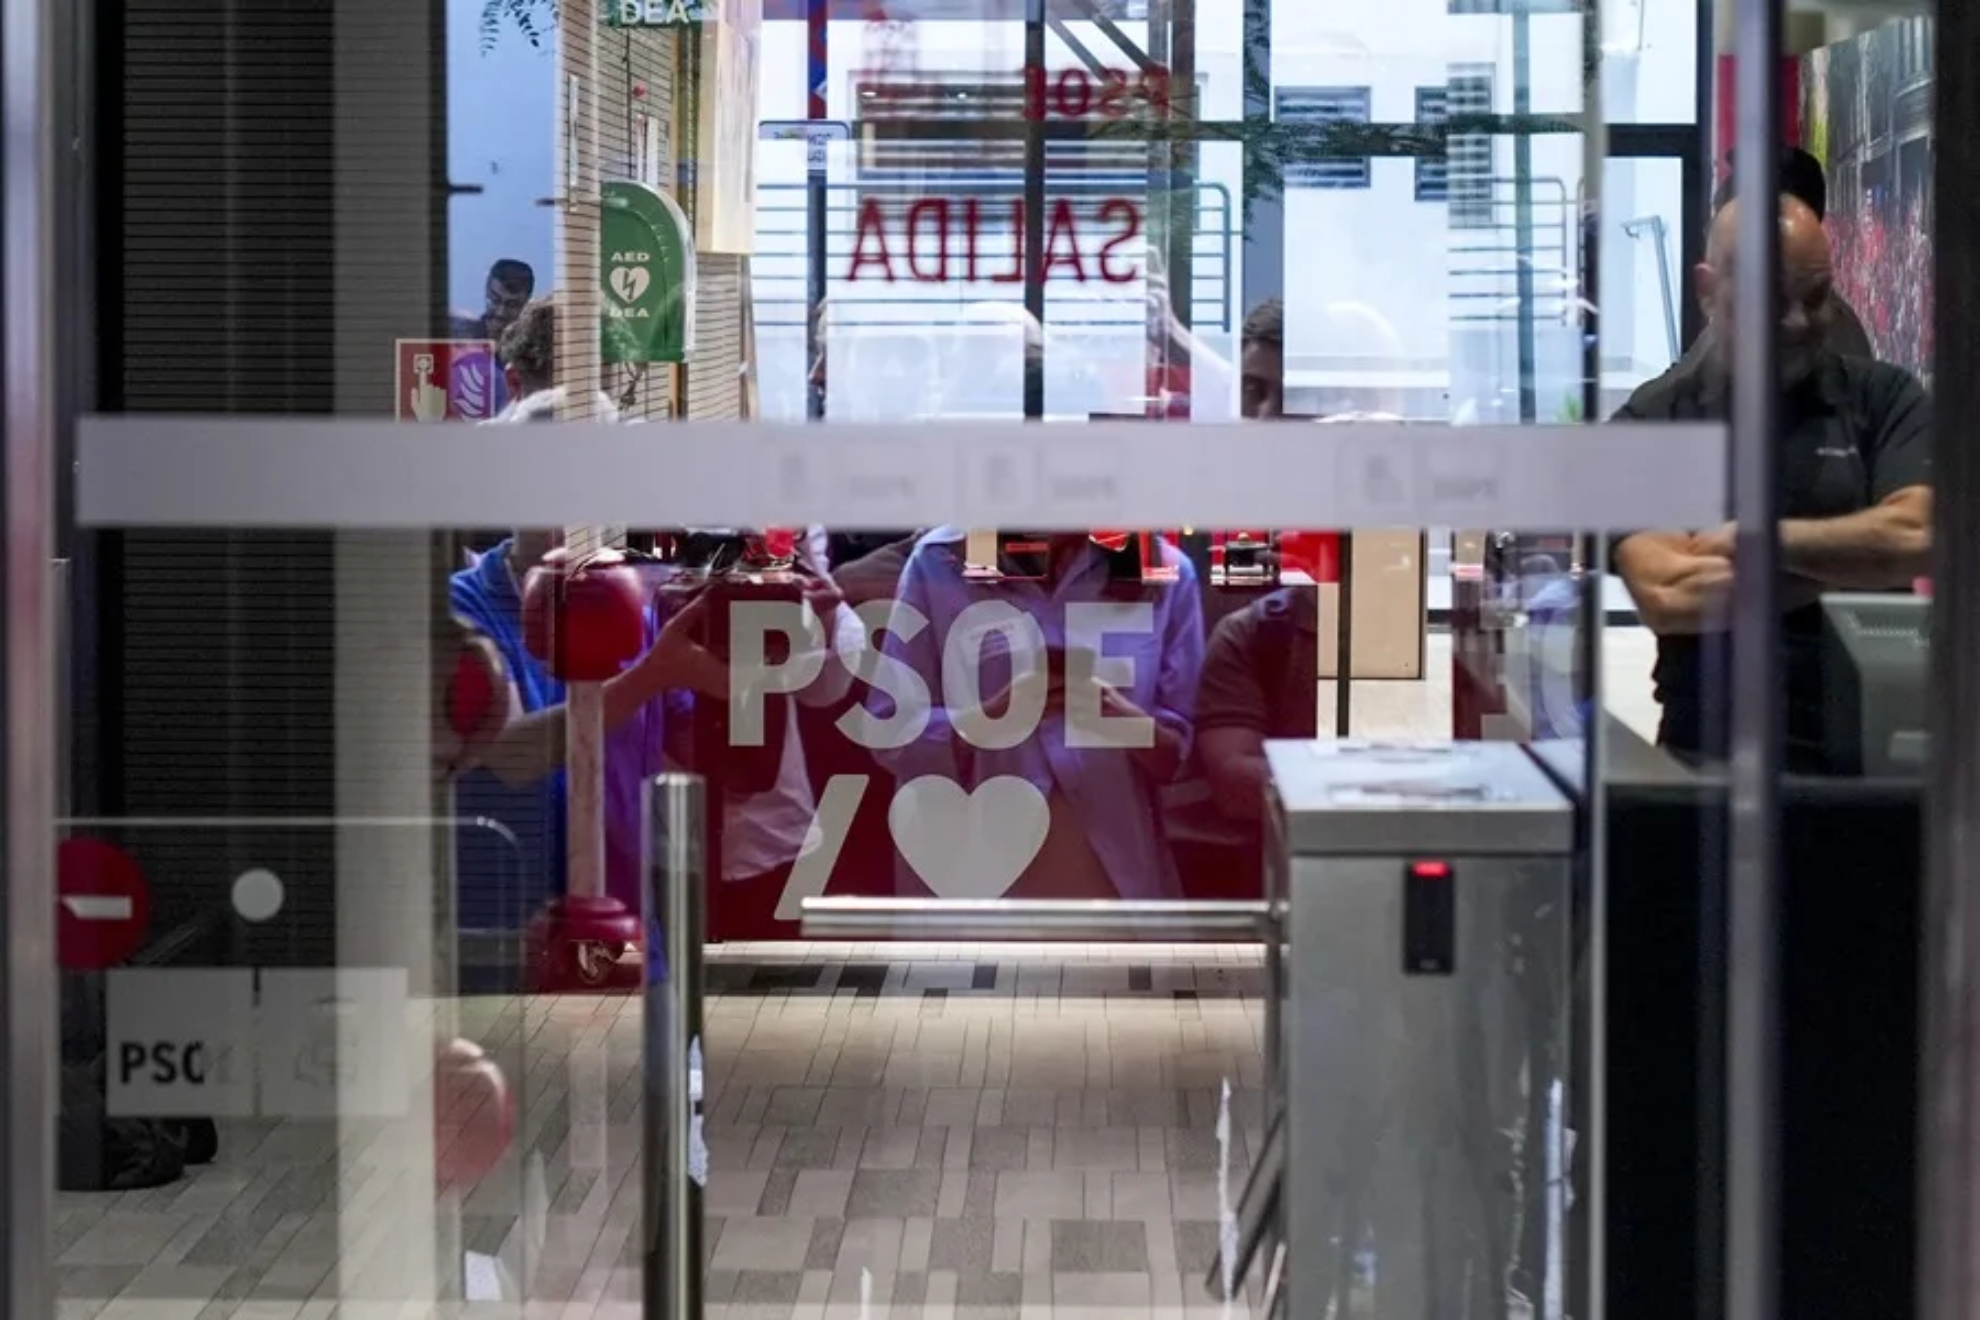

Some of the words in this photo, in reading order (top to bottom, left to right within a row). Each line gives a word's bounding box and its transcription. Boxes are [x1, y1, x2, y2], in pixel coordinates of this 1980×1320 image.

[611, 252, 650, 262] AED
[609, 307, 650, 318] DEA
[729, 599, 1155, 749] PSOE
[119, 1041, 226, 1084] PSO
